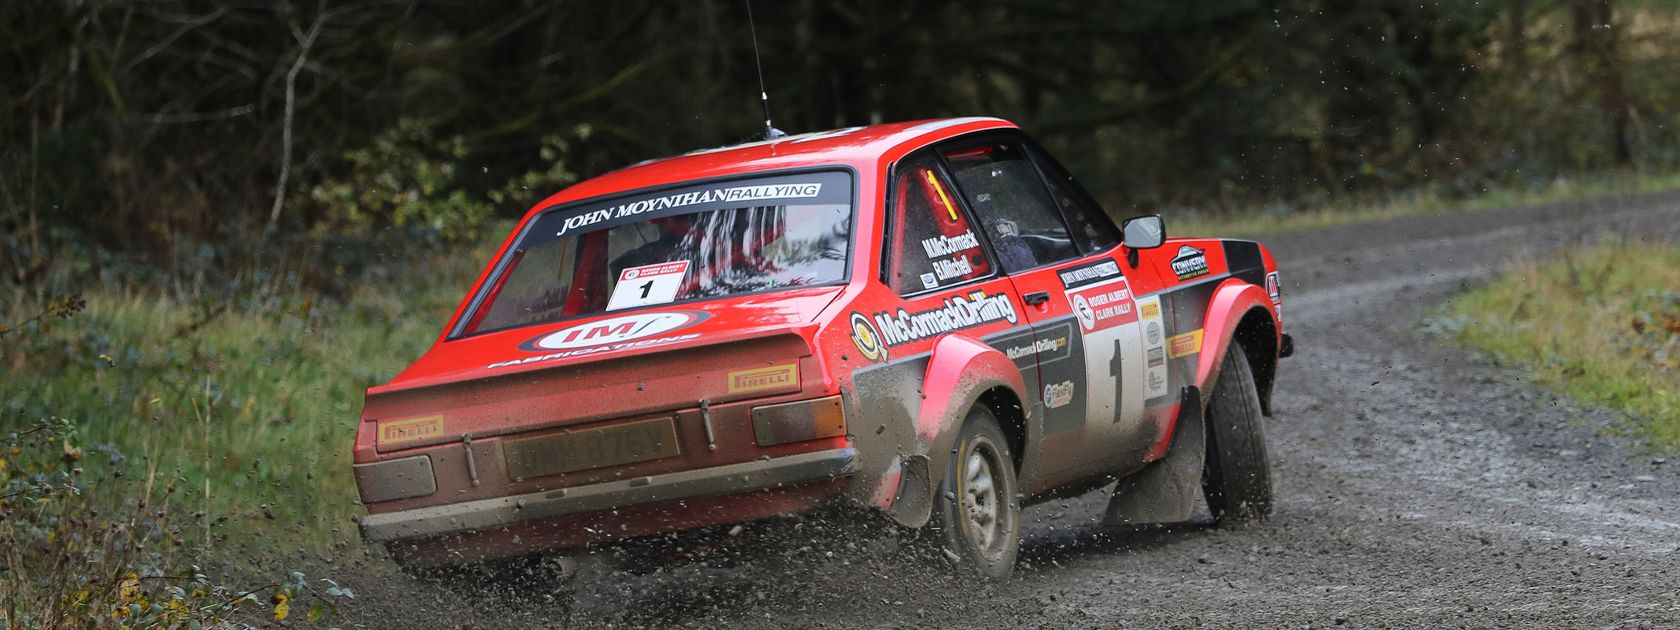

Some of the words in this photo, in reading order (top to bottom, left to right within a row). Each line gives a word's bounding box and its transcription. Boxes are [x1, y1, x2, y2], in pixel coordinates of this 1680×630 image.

[927, 170, 958, 221] 1
[557, 206, 613, 236] JOHN
[614, 188, 730, 219] MOYNIHAN
[728, 184, 819, 202] RALLYING
[639, 280, 654, 298] 1
[1088, 293, 1109, 308] ROGER
[1106, 288, 1130, 304] ALBERT
[1095, 308, 1115, 321] CLARK
[1112, 302, 1132, 317] RALLY
[734, 368, 790, 388] PIRELLI
[1109, 338, 1123, 423] 1
